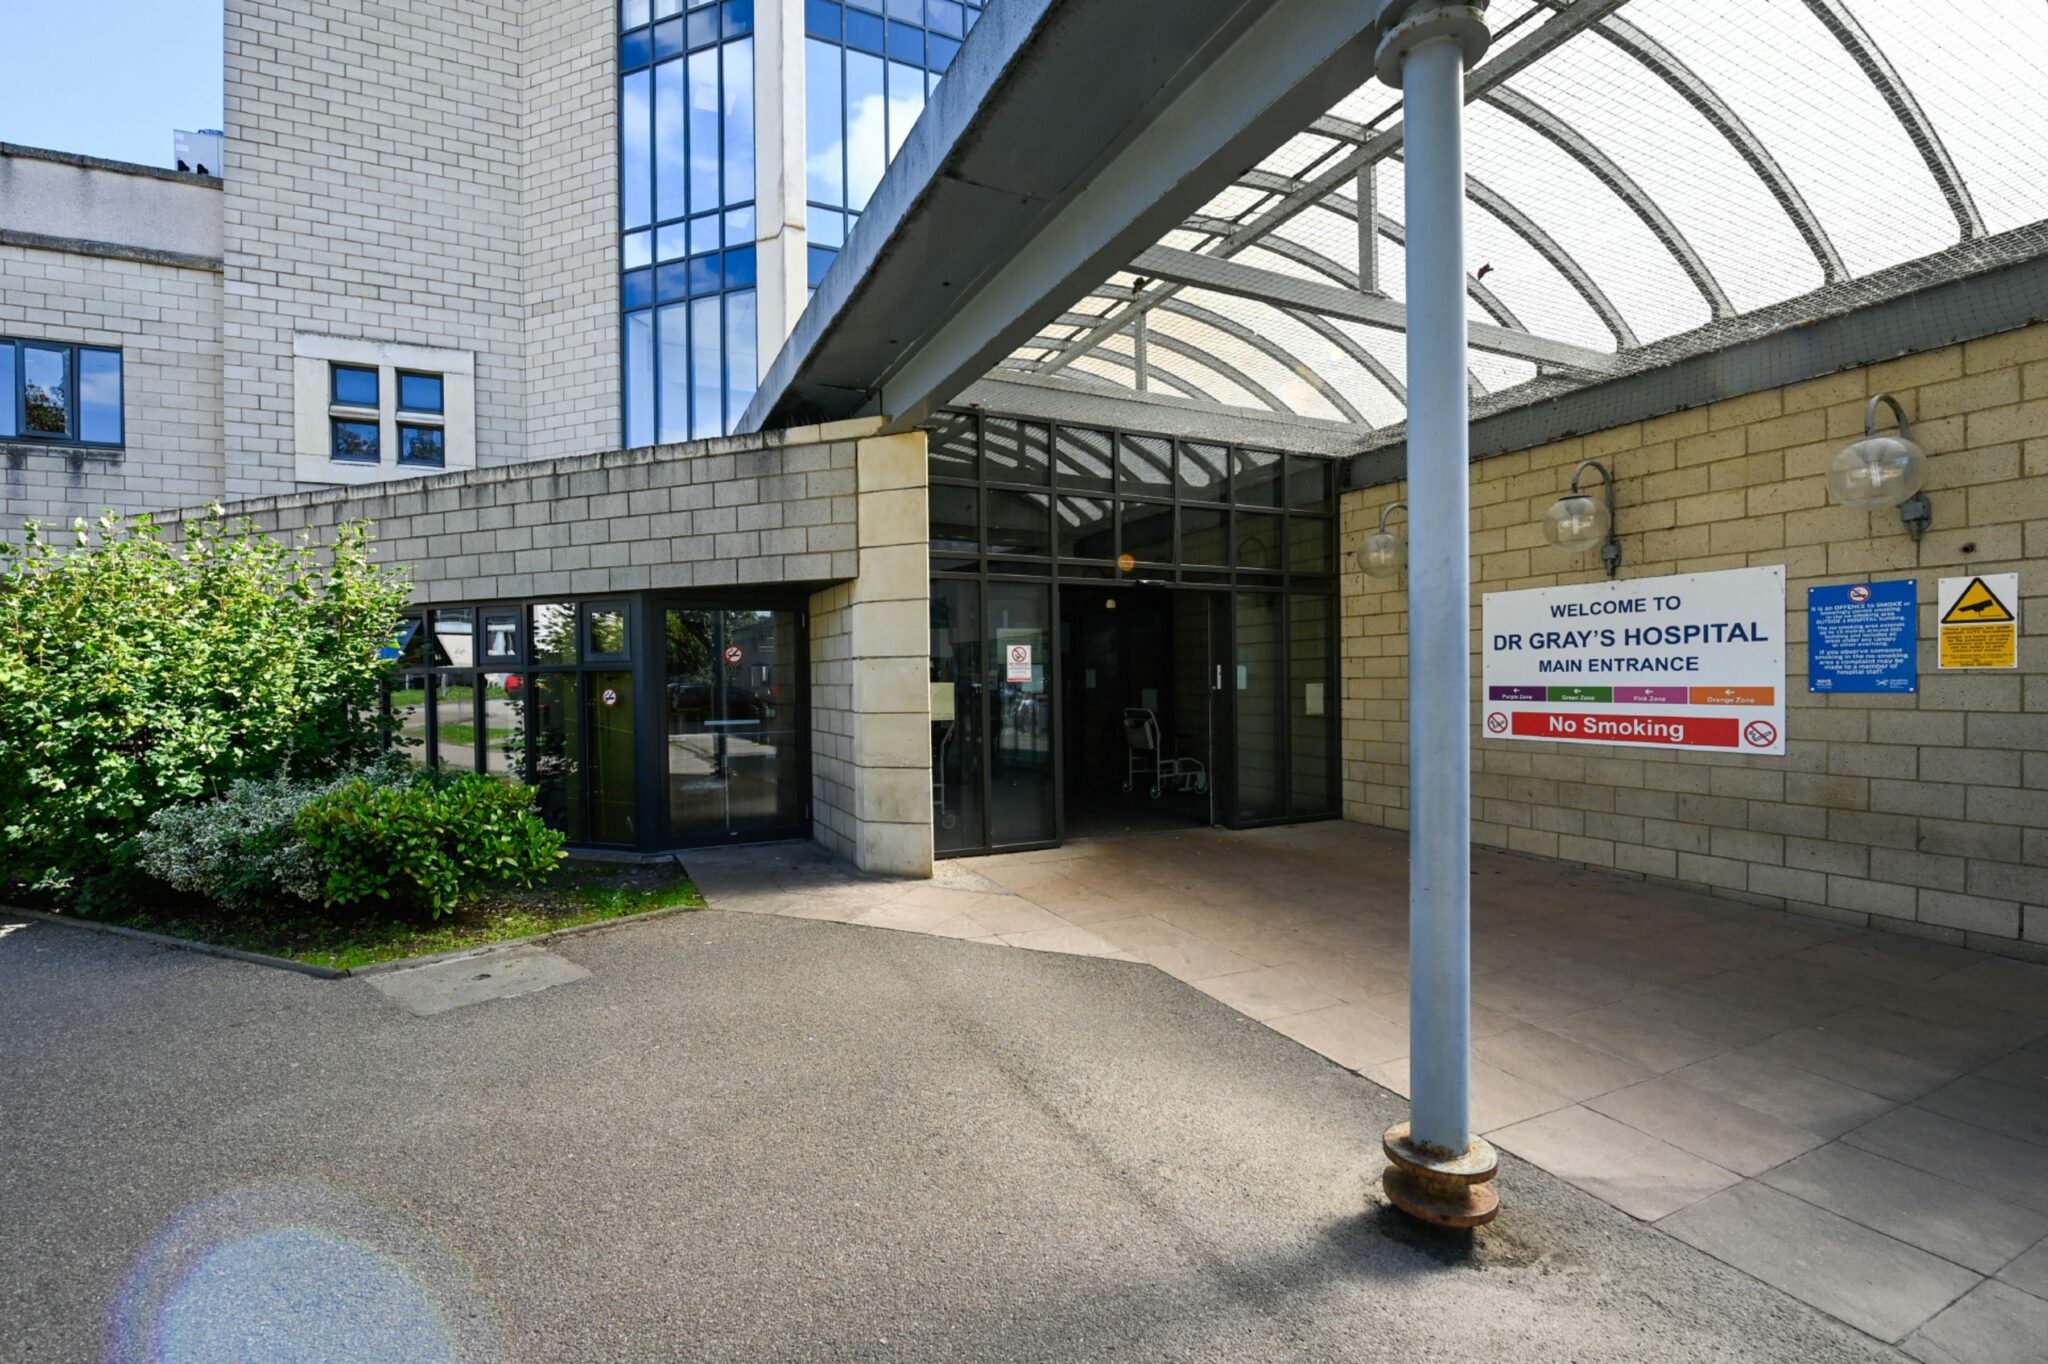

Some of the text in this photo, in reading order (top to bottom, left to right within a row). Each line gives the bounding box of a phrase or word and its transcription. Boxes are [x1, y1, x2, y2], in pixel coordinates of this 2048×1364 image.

[1550, 595, 1682, 618] WELCOME TO
[1493, 634, 1523, 651] DR
[1624, 621, 1769, 646] HOSPITAL
[1538, 656, 1699, 673] MAIN ENTRANCE
[1706, 696, 1734, 704] Orange
[1549, 715, 1685, 742] No Smoking
